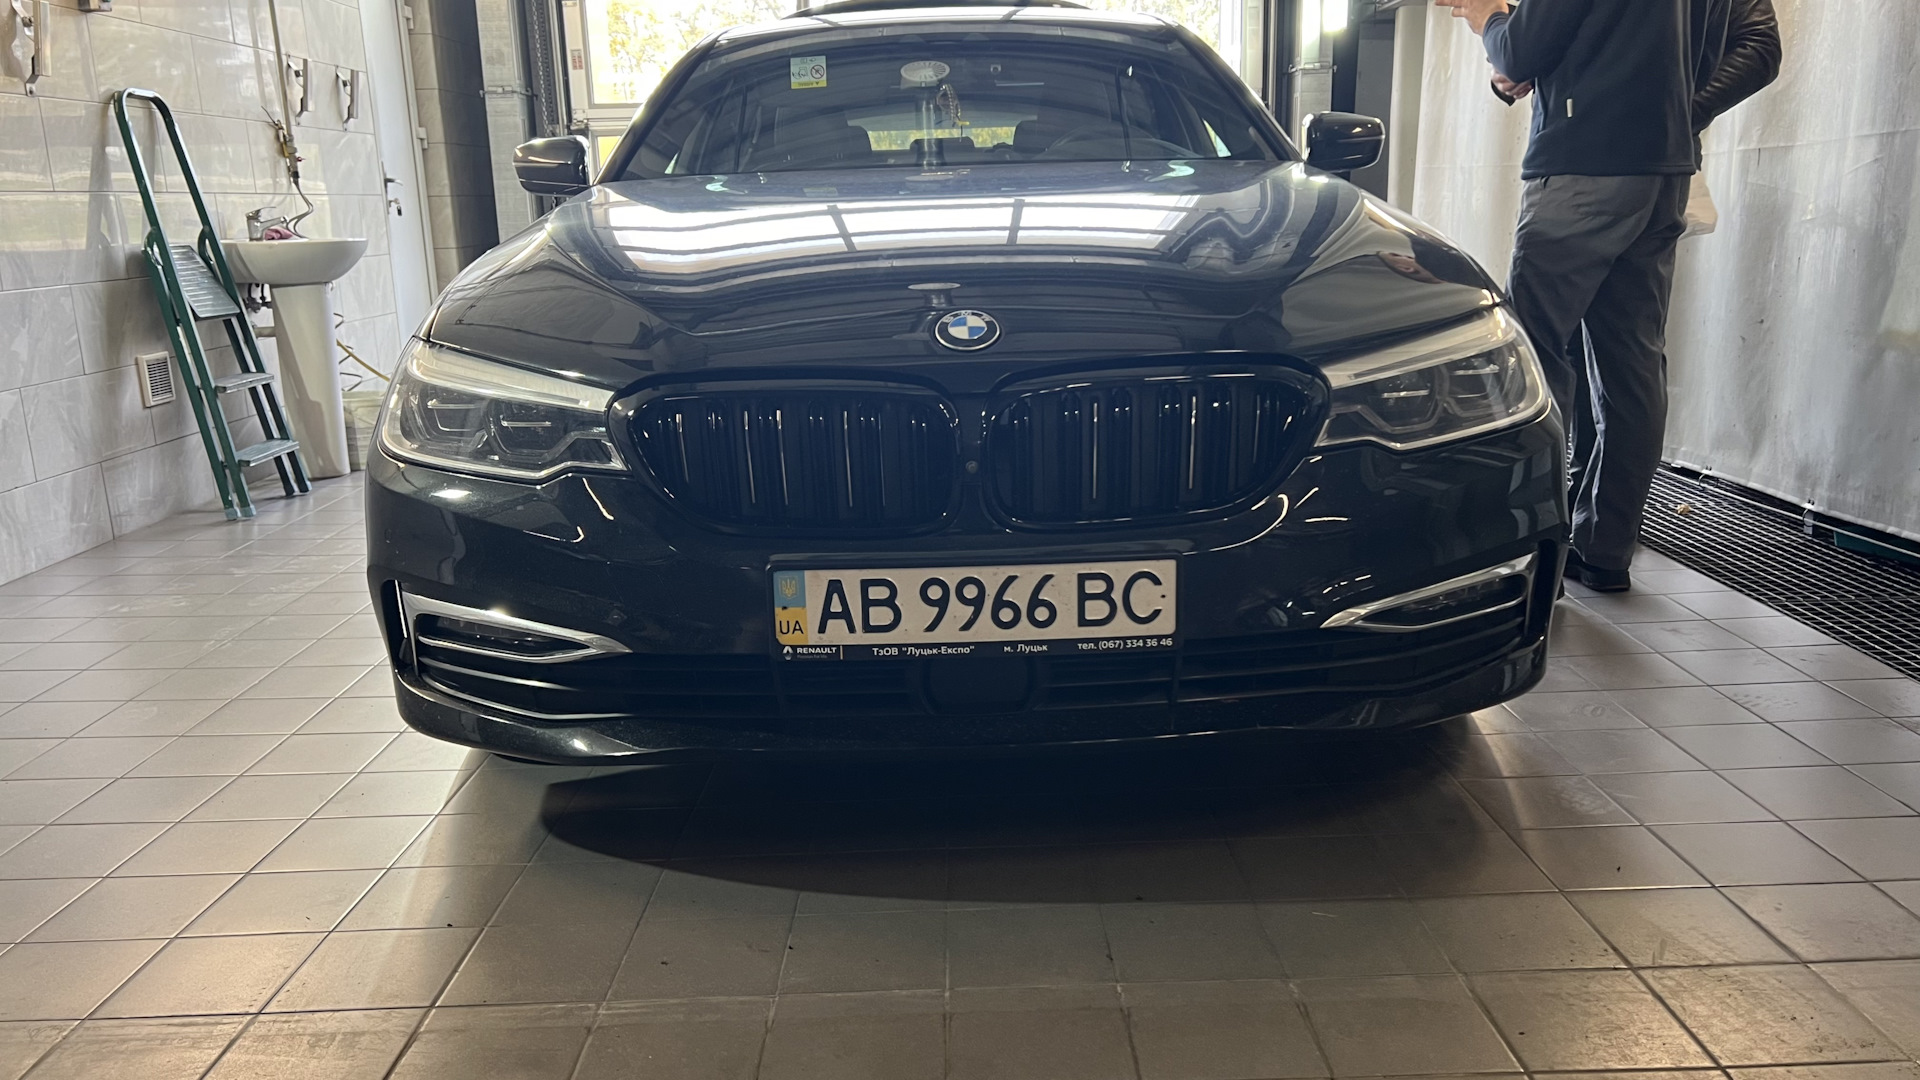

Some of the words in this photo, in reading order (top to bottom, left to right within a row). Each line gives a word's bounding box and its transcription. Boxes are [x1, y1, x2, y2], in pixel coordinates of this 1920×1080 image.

[818, 578, 902, 634] AB
[919, 574, 1058, 632] 9966
[1077, 570, 1163, 627] BC
[779, 620, 804, 635] UA
[796, 646, 837, 654] RENAULT
[872, 647, 898, 656] ТзОВ
[902, 645, 975, 657] "Луцьк-Експо"
[1016, 644, 1048, 653] Луцьк
[1077, 642, 1097, 650] тел.
[1098, 640, 1124, 650] (067)
[1125, 639, 1143, 648] 334
[1145, 638, 1158, 647] 36
[1160, 638, 1173, 646] 46
